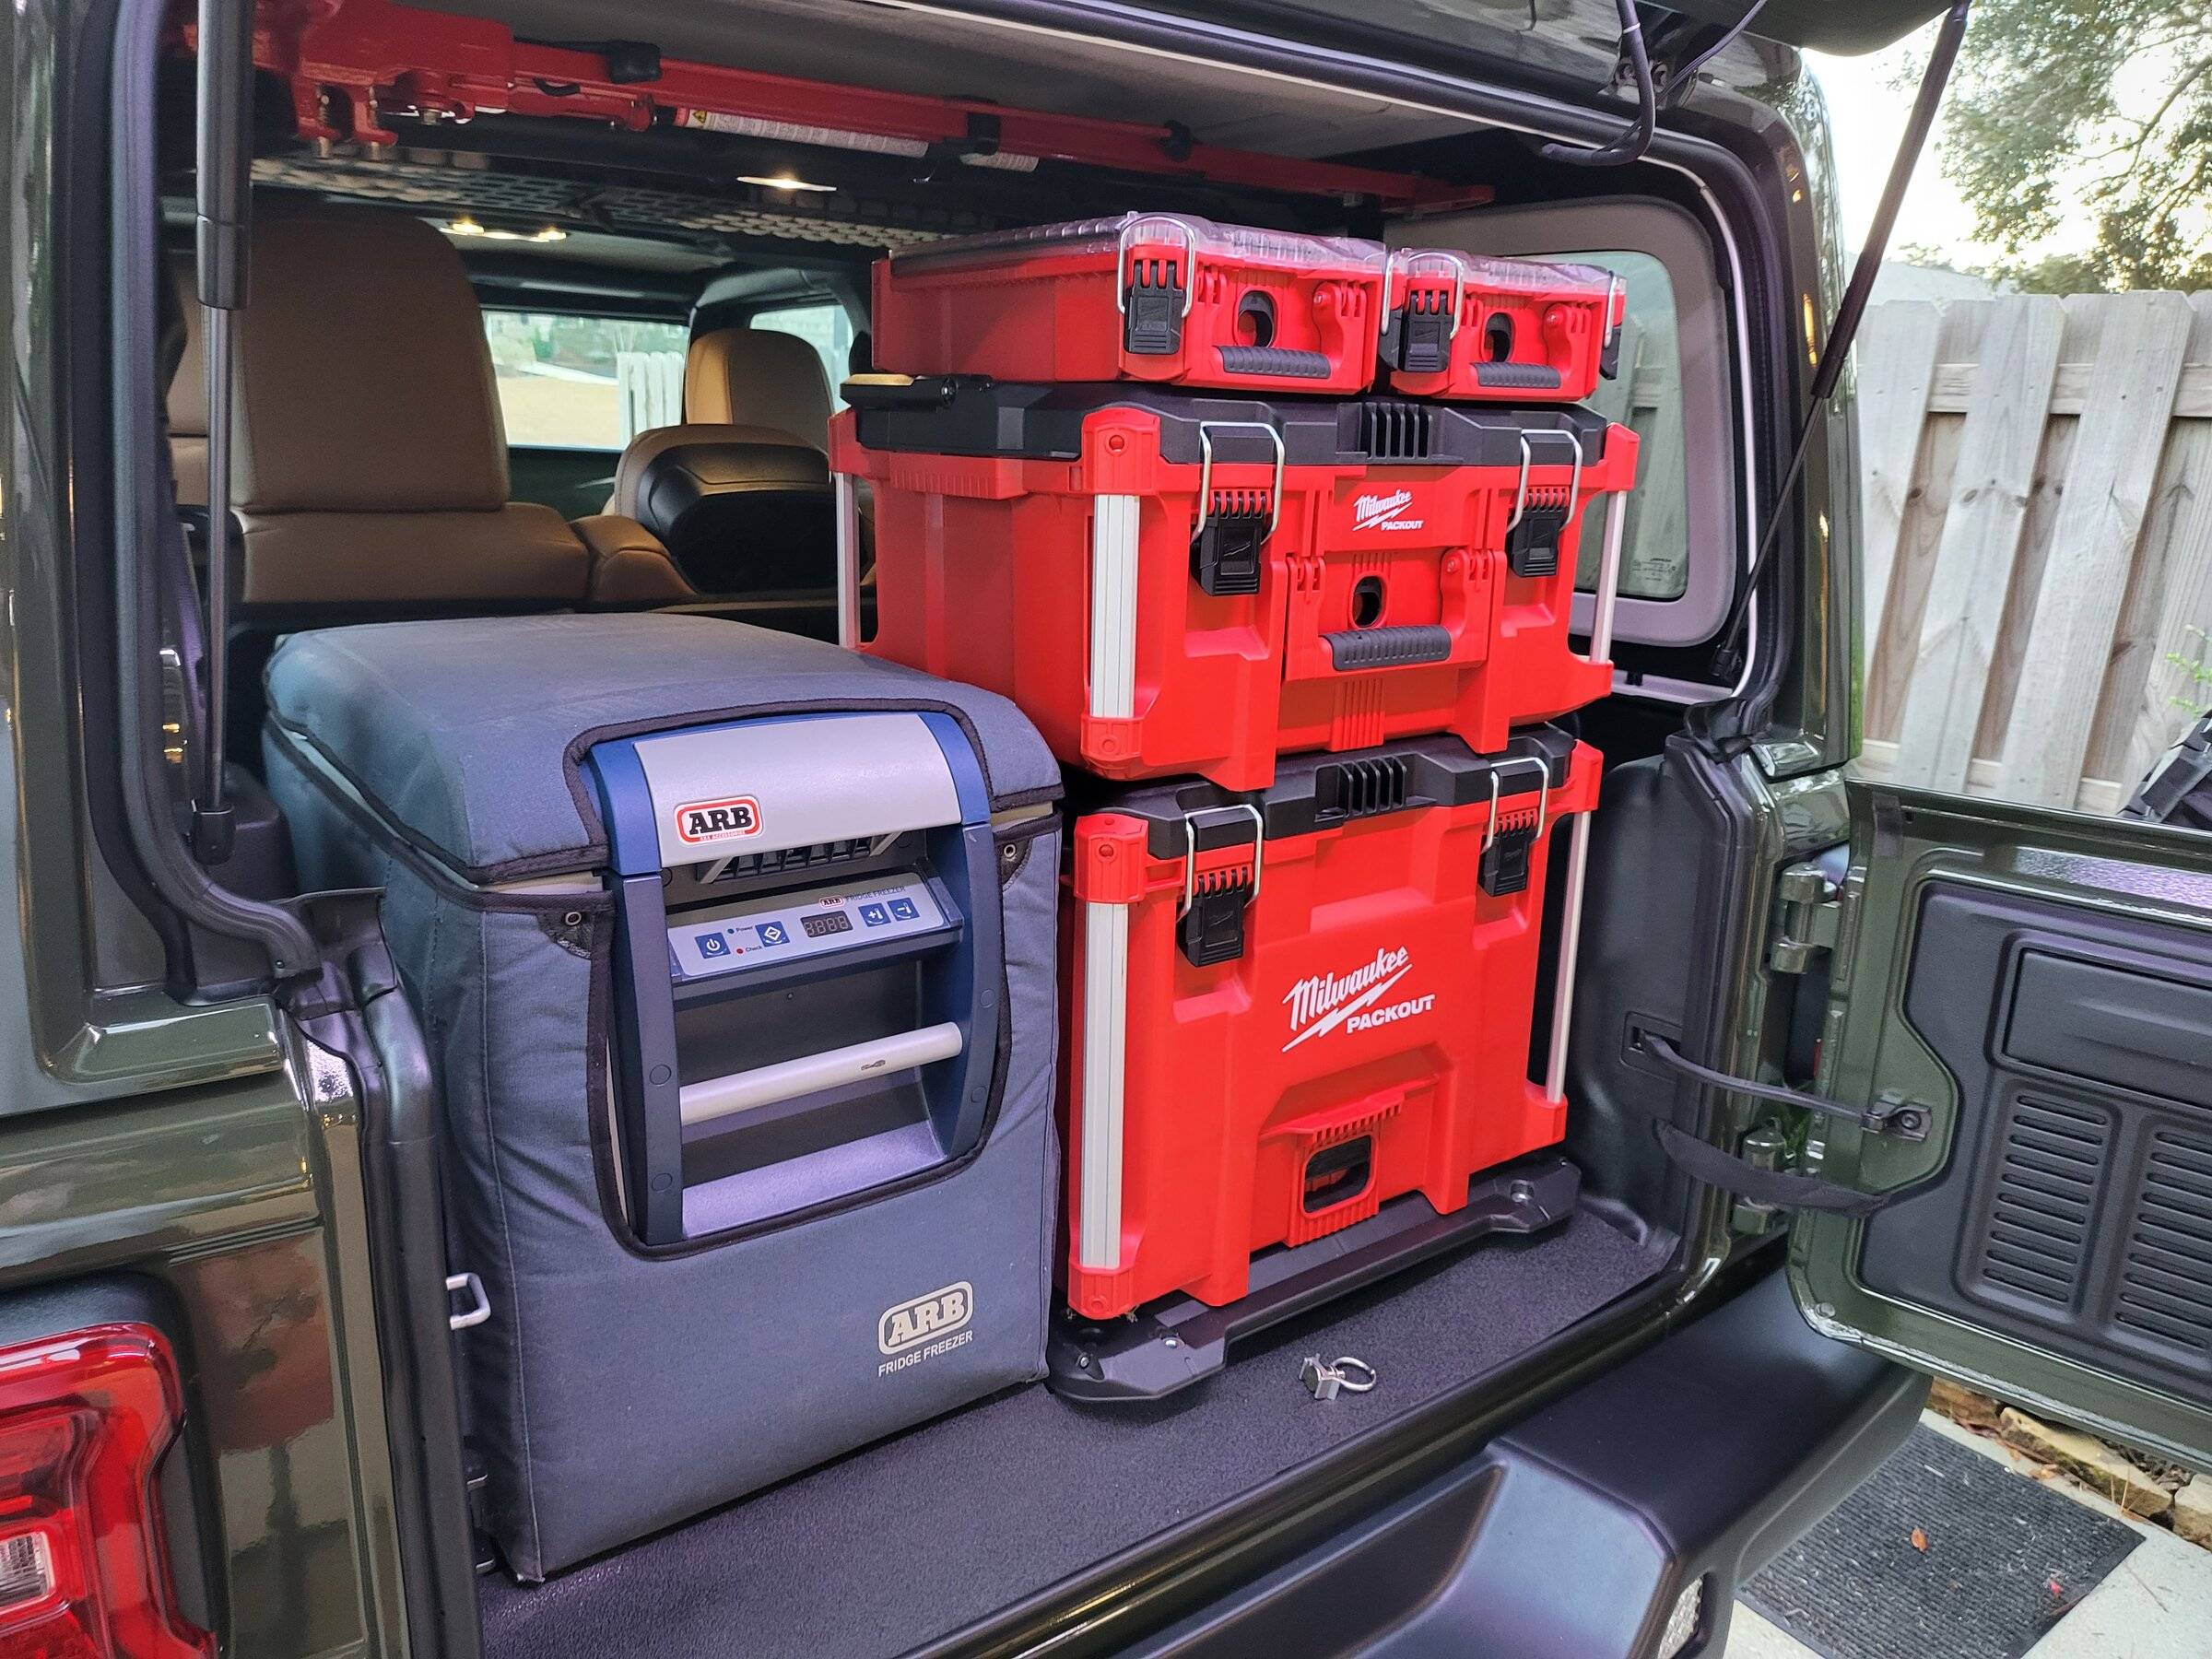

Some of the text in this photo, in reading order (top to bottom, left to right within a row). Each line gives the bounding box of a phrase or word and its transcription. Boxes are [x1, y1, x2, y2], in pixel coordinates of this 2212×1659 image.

[1353, 488, 1412, 522] Milwaukee
[1381, 521, 1424, 531] PACKOUT
[688, 806, 753, 835] ARB
[822, 886, 906, 907] ARB FRIDGE FREEZER
[1282, 946, 1409, 1031] Milwaukee
[1347, 994, 1435, 1034] PACKOUT
[888, 1291, 965, 1347] ARB
[878, 1330, 973, 1377] FRIDGE FREEZER
